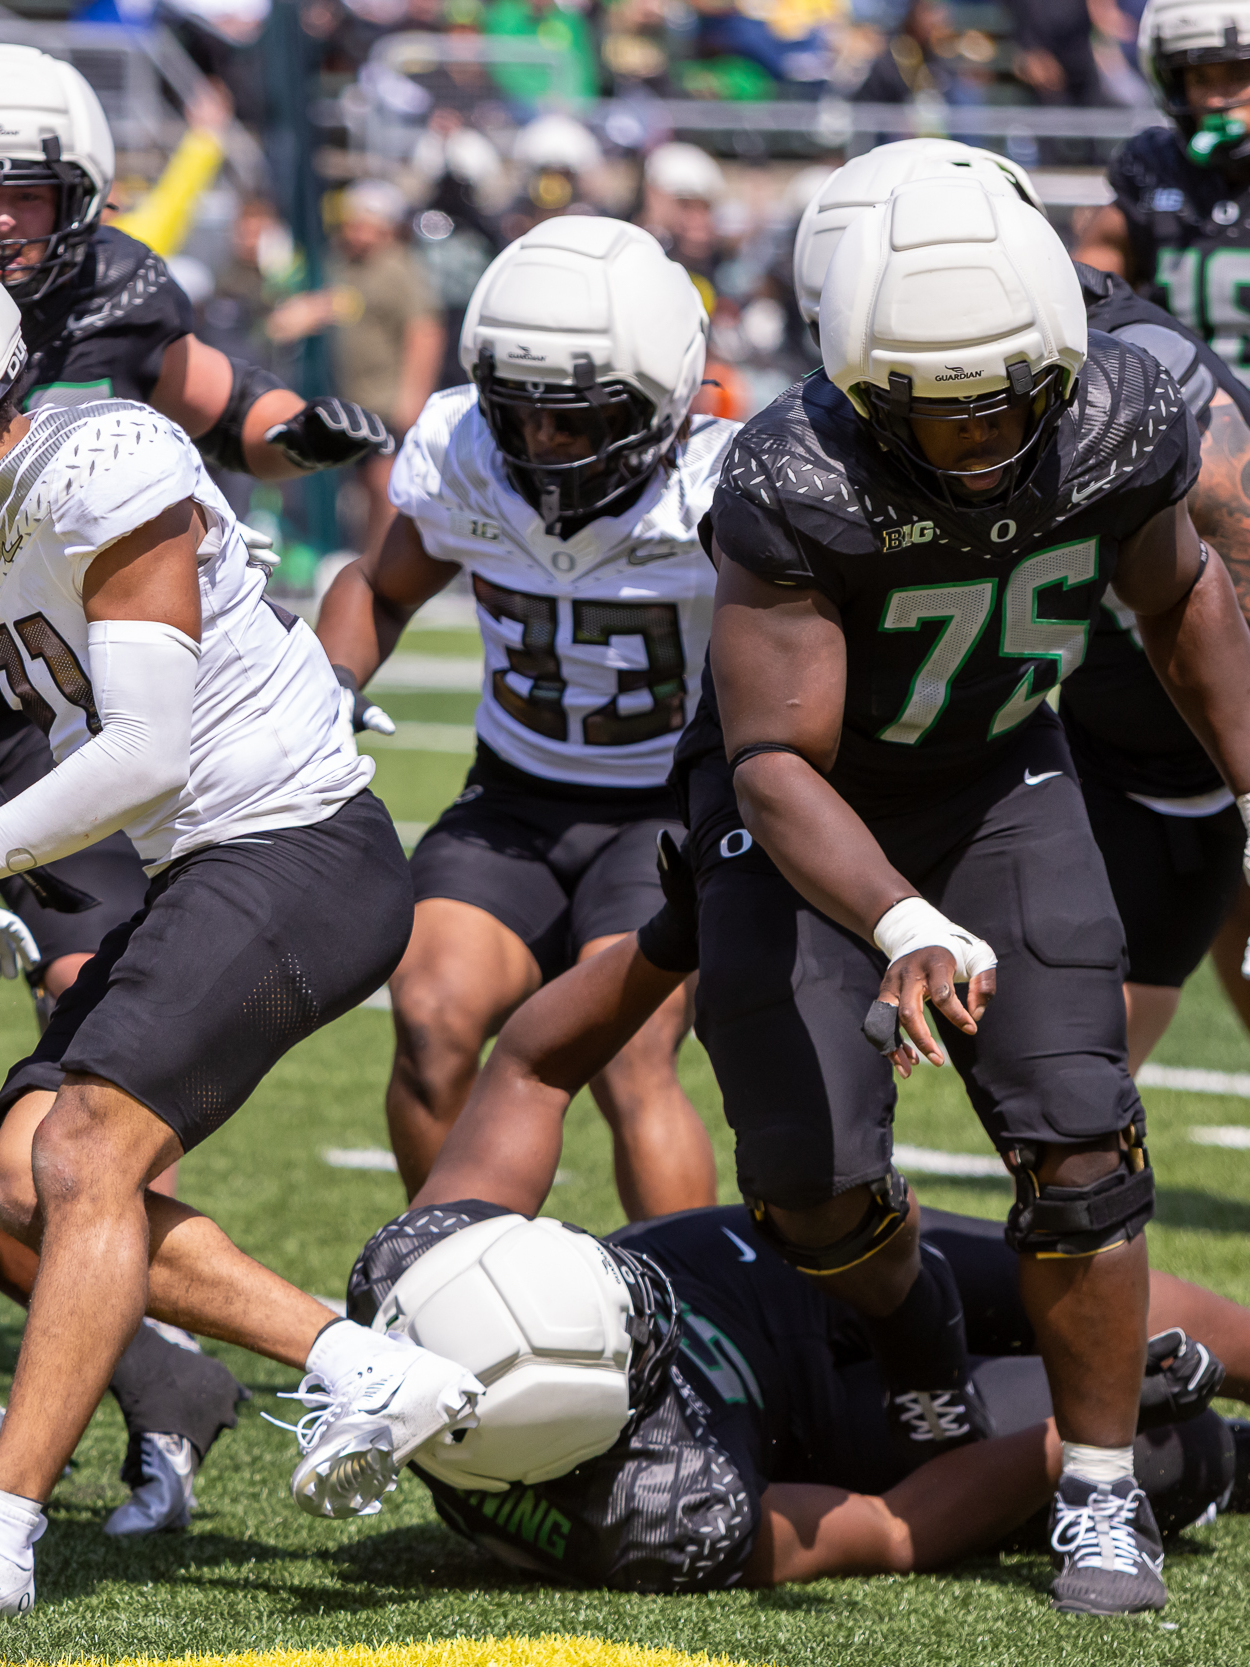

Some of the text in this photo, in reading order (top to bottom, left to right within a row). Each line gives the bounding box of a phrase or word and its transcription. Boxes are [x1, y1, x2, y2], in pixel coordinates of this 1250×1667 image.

[990, 519, 1017, 543] O
[472, 570, 688, 746] 33
[875, 534, 1100, 746] 75
[720, 828, 753, 858] O
